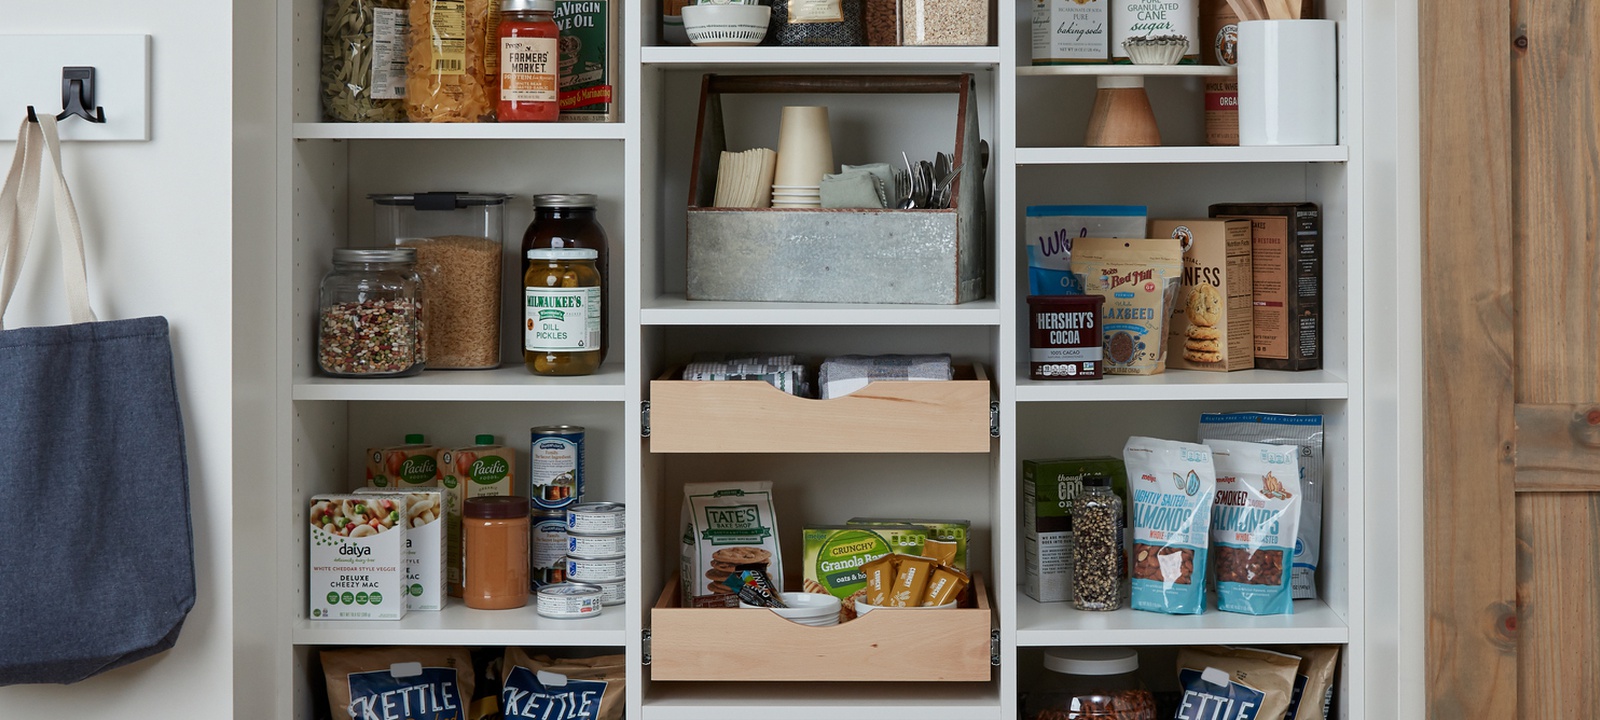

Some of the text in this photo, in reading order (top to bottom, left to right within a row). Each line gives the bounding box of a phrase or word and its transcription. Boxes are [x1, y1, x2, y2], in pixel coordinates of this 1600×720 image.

[562, 2, 600, 16] VIRGIN
[1127, 3, 1179, 12] GRANULATED
[1137, 10, 1167, 20] CANE
[574, 14, 594, 28] OIL
[1129, 21, 1174, 36] sugar
[1056, 22, 1085, 41] baking
[1220, 97, 1238, 106] ORGA
[1110, 273, 1131, 290] Red
[1132, 269, 1153, 287] Mill
[1180, 267, 1220, 287] NESS
[527, 295, 582, 308] MILWAUKEE'S
[1037, 312, 1094, 330] HERSHEY'S
[1102, 307, 1154, 320] LAXSEED
[543, 323, 560, 331] DILL
[536, 332, 568, 340] PICKLES
[1050, 330, 1080, 345] COCOA
[402, 459, 434, 476] Pacific
[472, 460, 505, 477] Pacific
[1058, 482, 1083, 500] GRO
[1214, 490, 1247, 506] SMOKED
[1161, 494, 1185, 507] SALTED
[709, 508, 756, 523] TATE'S
[1134, 502, 1192, 533] ALMONDS
[1149, 530, 1164, 540] WHOLE
[1235, 533, 1252, 541] WHOL
[339, 543, 371, 557] daiya
[832, 542, 874, 555] CRUNCHY
[821, 556, 864, 572] Granola
[836, 575, 851, 583] oats
[347, 682, 457, 720] KETTLE
[503, 686, 597, 720] KETTLE
[1176, 690, 1255, 720] ETTLE
